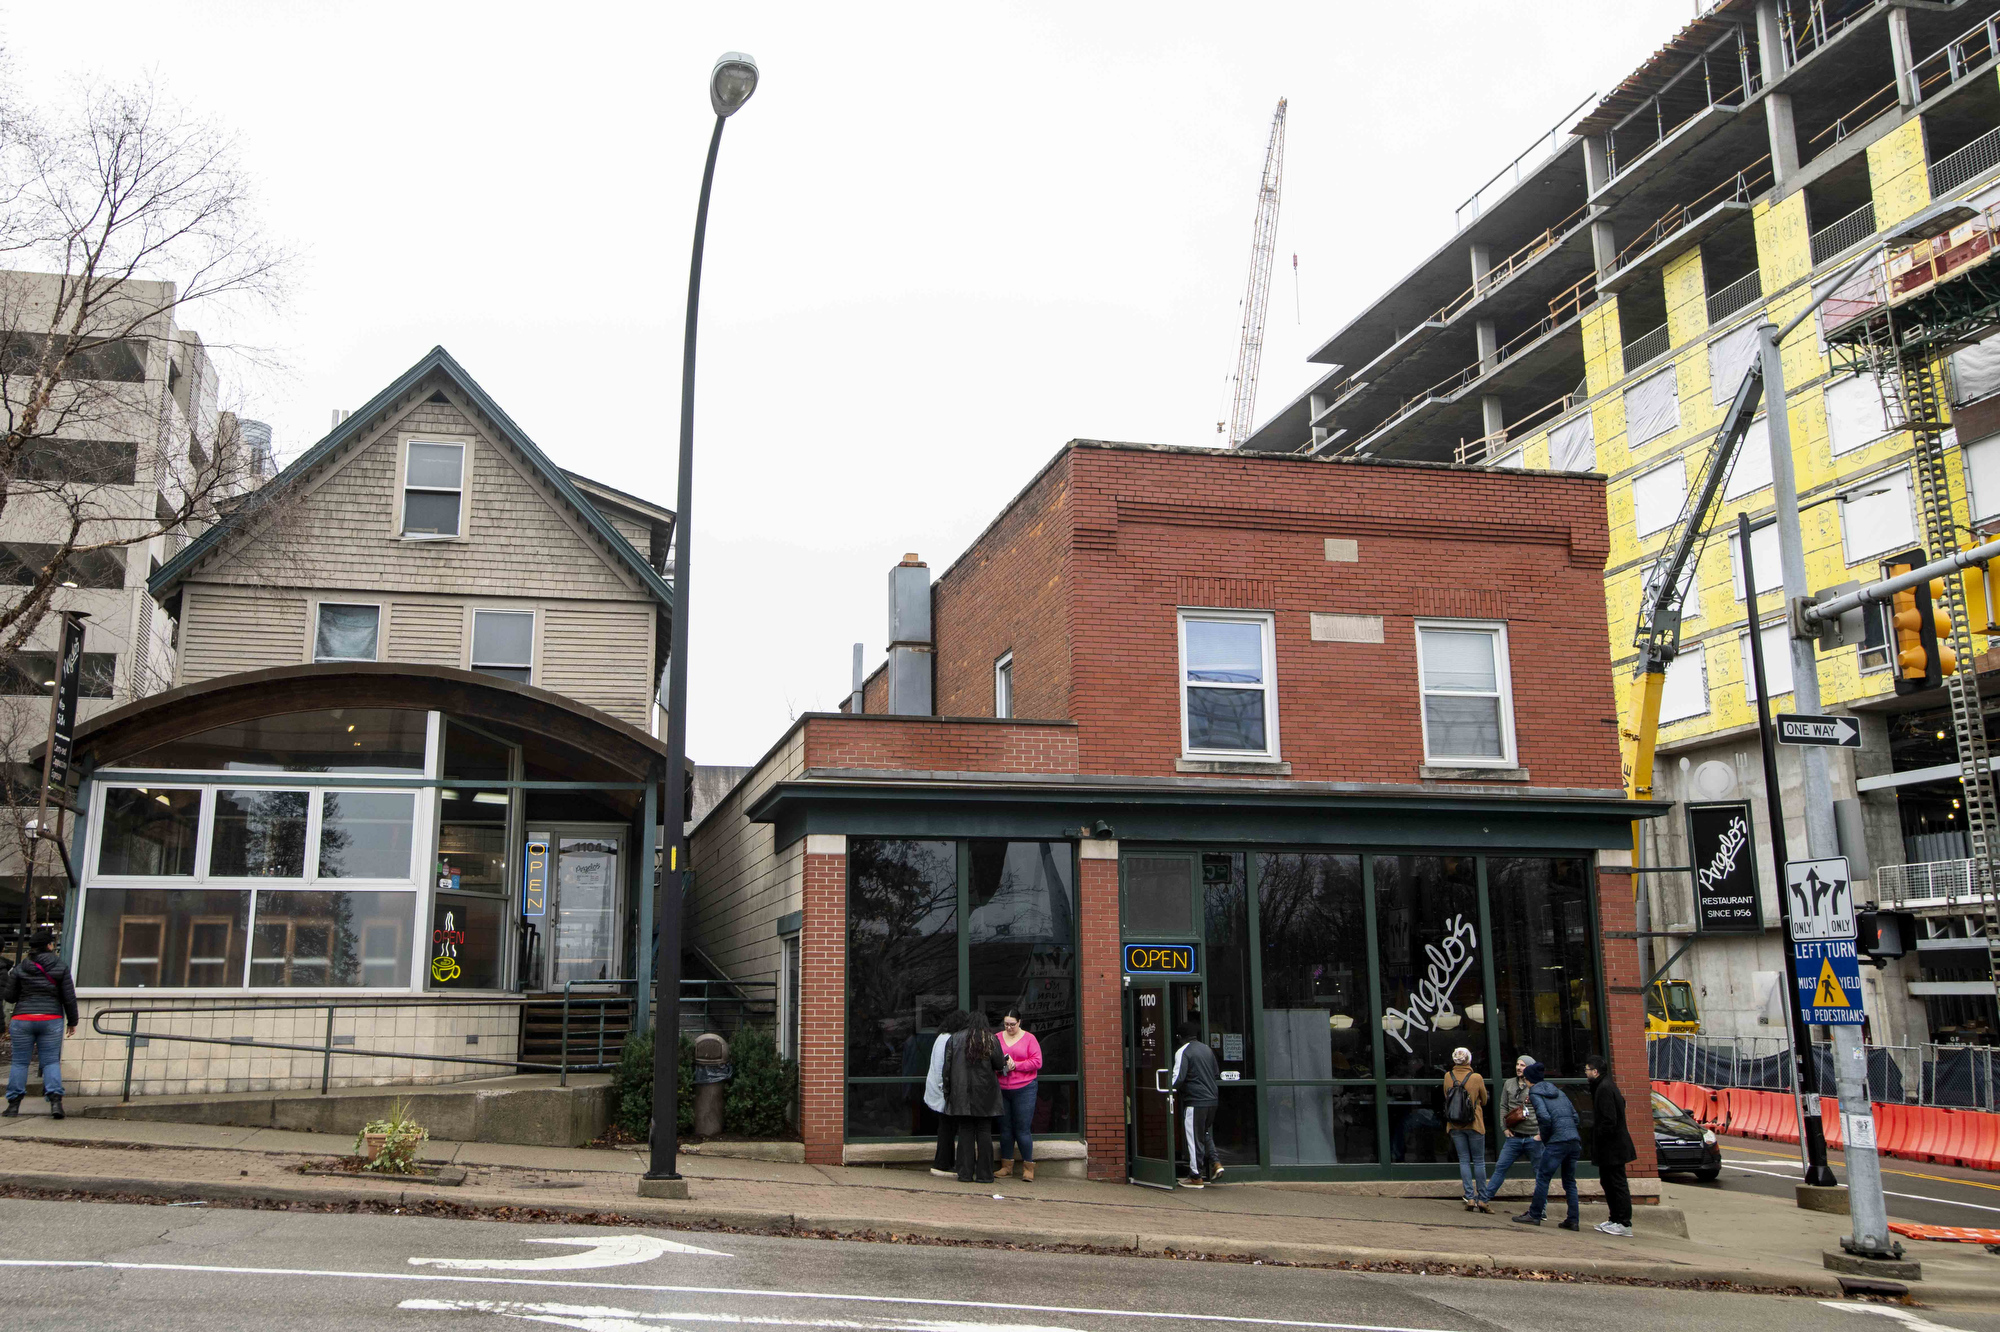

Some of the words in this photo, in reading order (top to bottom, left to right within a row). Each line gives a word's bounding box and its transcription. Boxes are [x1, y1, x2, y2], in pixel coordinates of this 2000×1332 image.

[1786, 723, 1809, 735] ONE
[1812, 724, 1836, 737] WAY
[574, 842, 603, 852] 1104
[1699, 815, 1747, 891] Angelo's
[527, 843, 546, 909] OPEN
[1702, 896, 1753, 905] RESTAURANT
[1707, 909, 1731, 918] SINCE
[1733, 909, 1752, 917] 1956
[1793, 921, 1812, 934] ONLY
[1831, 919, 1851, 932] ONLY
[433, 929, 465, 945] OPEN
[1795, 943, 1821, 959] LEFT
[1825, 942, 1856, 958] TURN
[1131, 948, 1188, 969] OPEN
[1385, 913, 1477, 1053] Angelo's
[1798, 977, 1817, 990] MUST
[1838, 976, 1861, 989] YIELD
[1139, 994, 1156, 1007] 1100
[1801, 1008, 1811, 1022] TO
[1814, 1009, 1865, 1023] PEDESTRIANS
